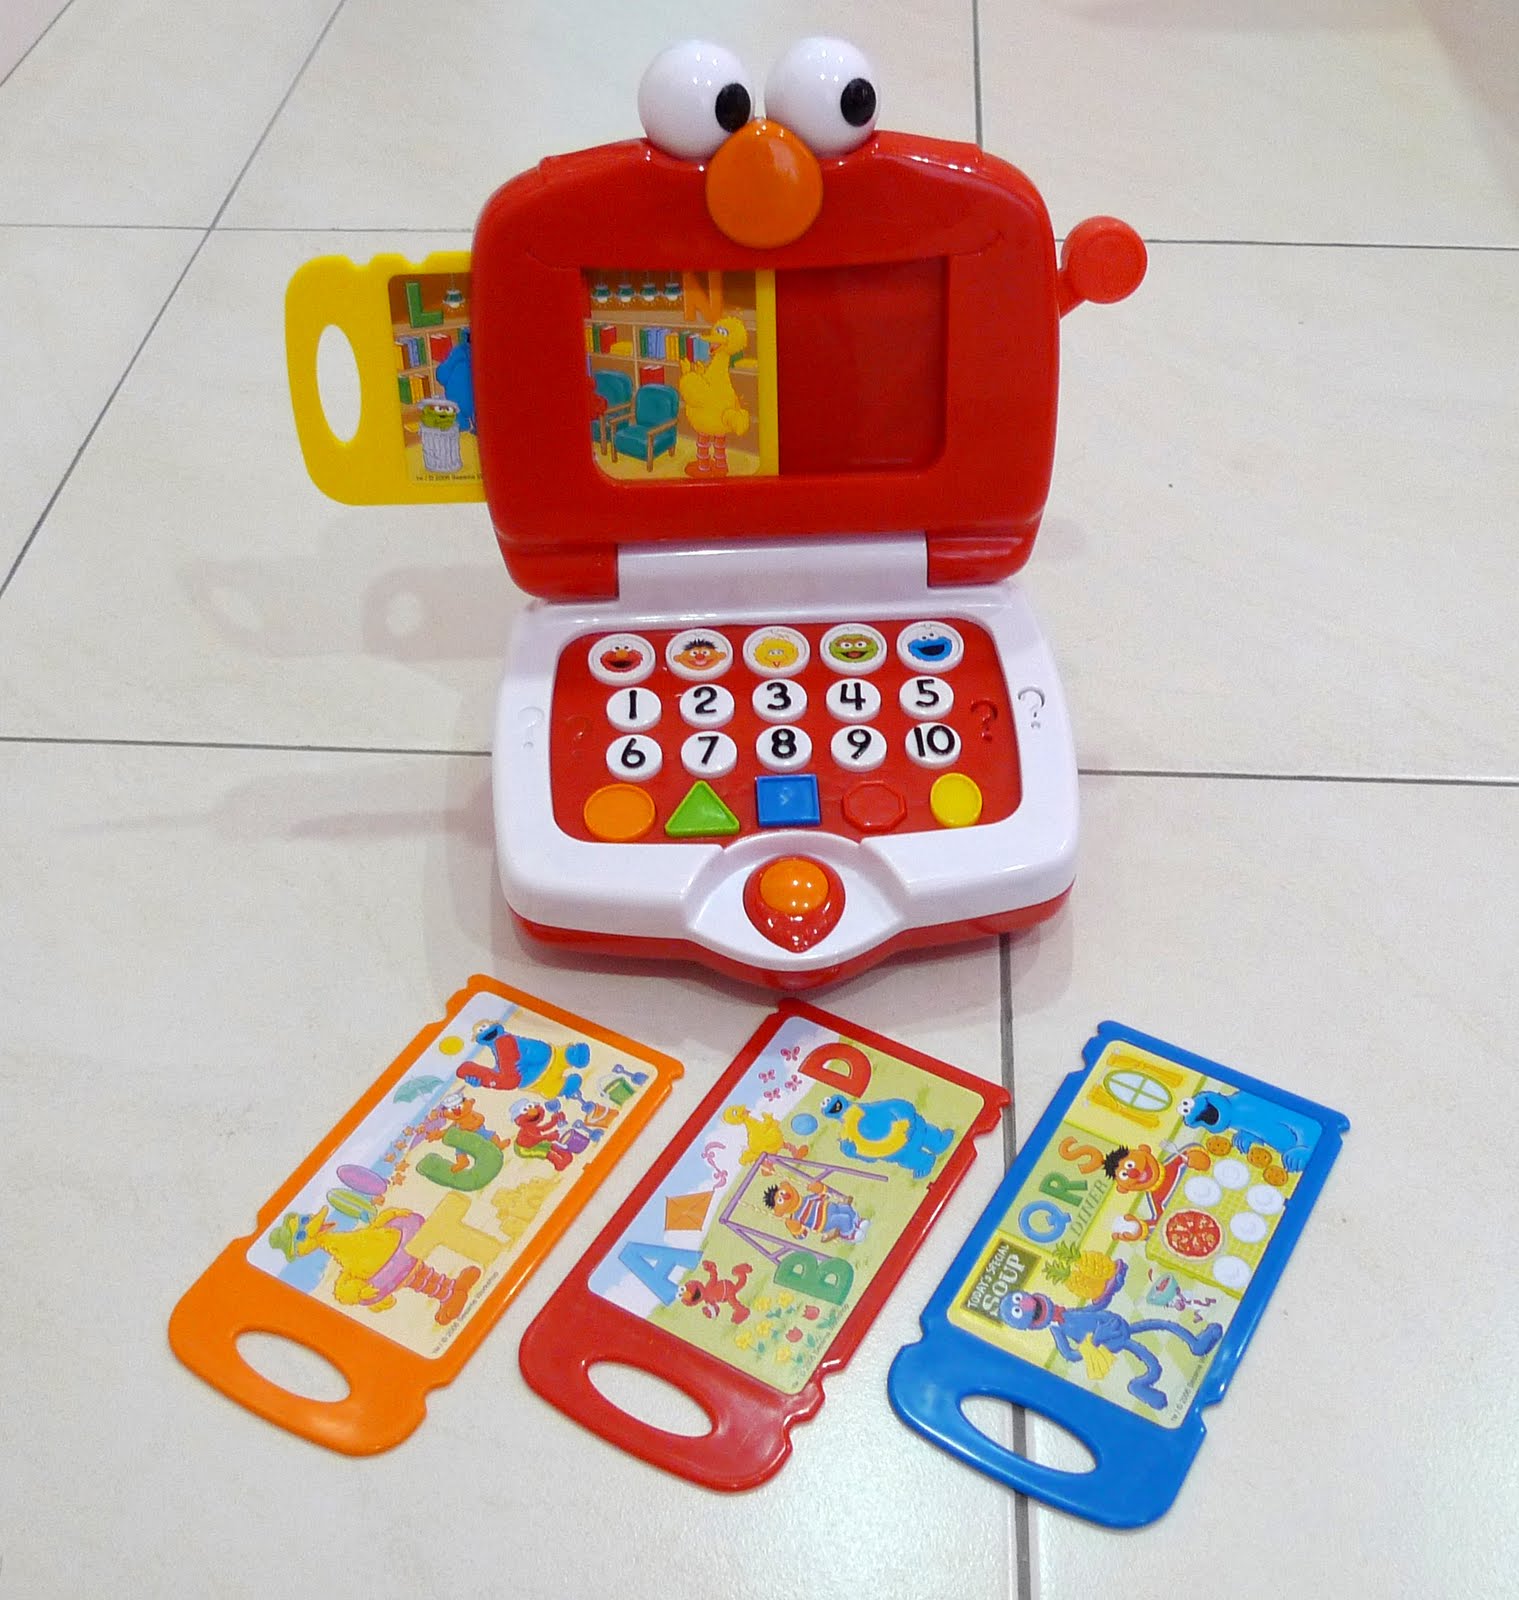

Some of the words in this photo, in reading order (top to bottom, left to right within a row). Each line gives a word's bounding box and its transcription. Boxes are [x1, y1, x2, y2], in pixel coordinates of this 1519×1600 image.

[405, 281, 444, 328] L
[683, 270, 725, 322] N
[628, 689, 638, 720] 1
[692, 686, 718, 715] 2
[766, 682, 792, 711] 3
[839, 682, 867, 711] 4
[915, 679, 940, 708] 5
[620, 737, 647, 769] 6
[697, 735, 720, 765] 7
[770, 728, 798, 759] 8
[846, 728, 873, 760] 9
[913, 725, 956, 758] 10
[797, 1042, 873, 1098] D
[415, 1125, 505, 1192] U
[839, 1106, 911, 1158] C
[405, 1191, 513, 1271] T
[1069, 1179, 1108, 1238] DINER
[617, 1241, 704, 1306] A
[773, 1251, 855, 1306] B
[982, 1253, 1026, 1317] SOUP
[985, 1242, 1011, 1278] SPECIAL
